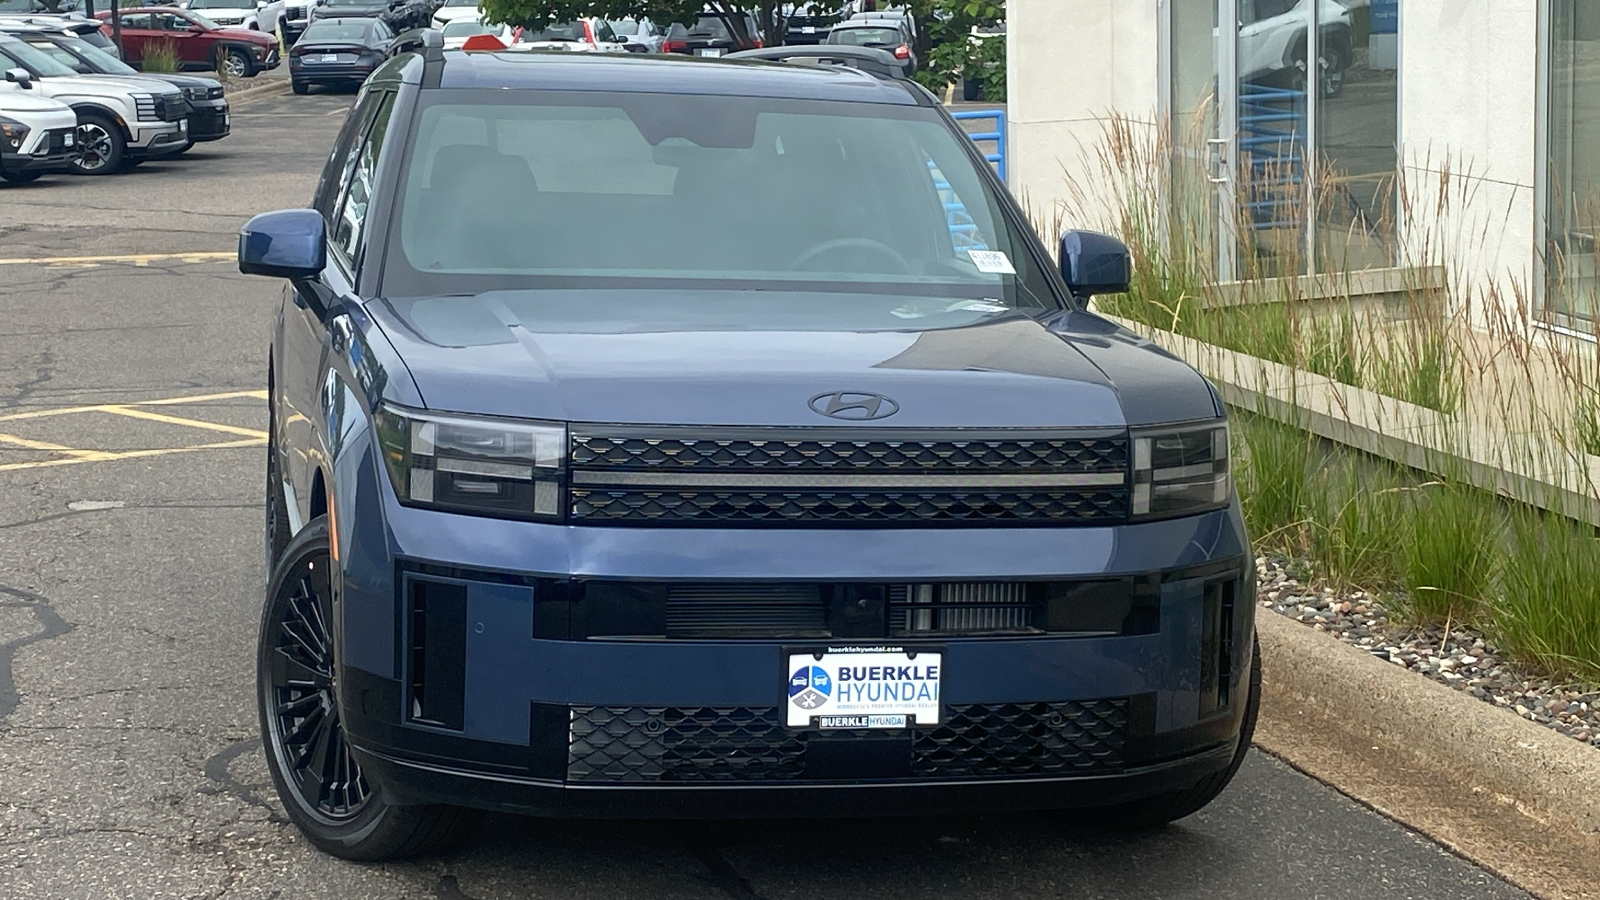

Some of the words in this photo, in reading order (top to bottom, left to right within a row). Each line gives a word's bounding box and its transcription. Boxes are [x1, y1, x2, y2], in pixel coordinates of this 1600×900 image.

[838, 666, 938, 681] BUERKLE
[837, 682, 938, 702] HYUNDAI
[821, 717, 868, 727] BUERKLE
[870, 717, 904, 726] HYUNDAI
